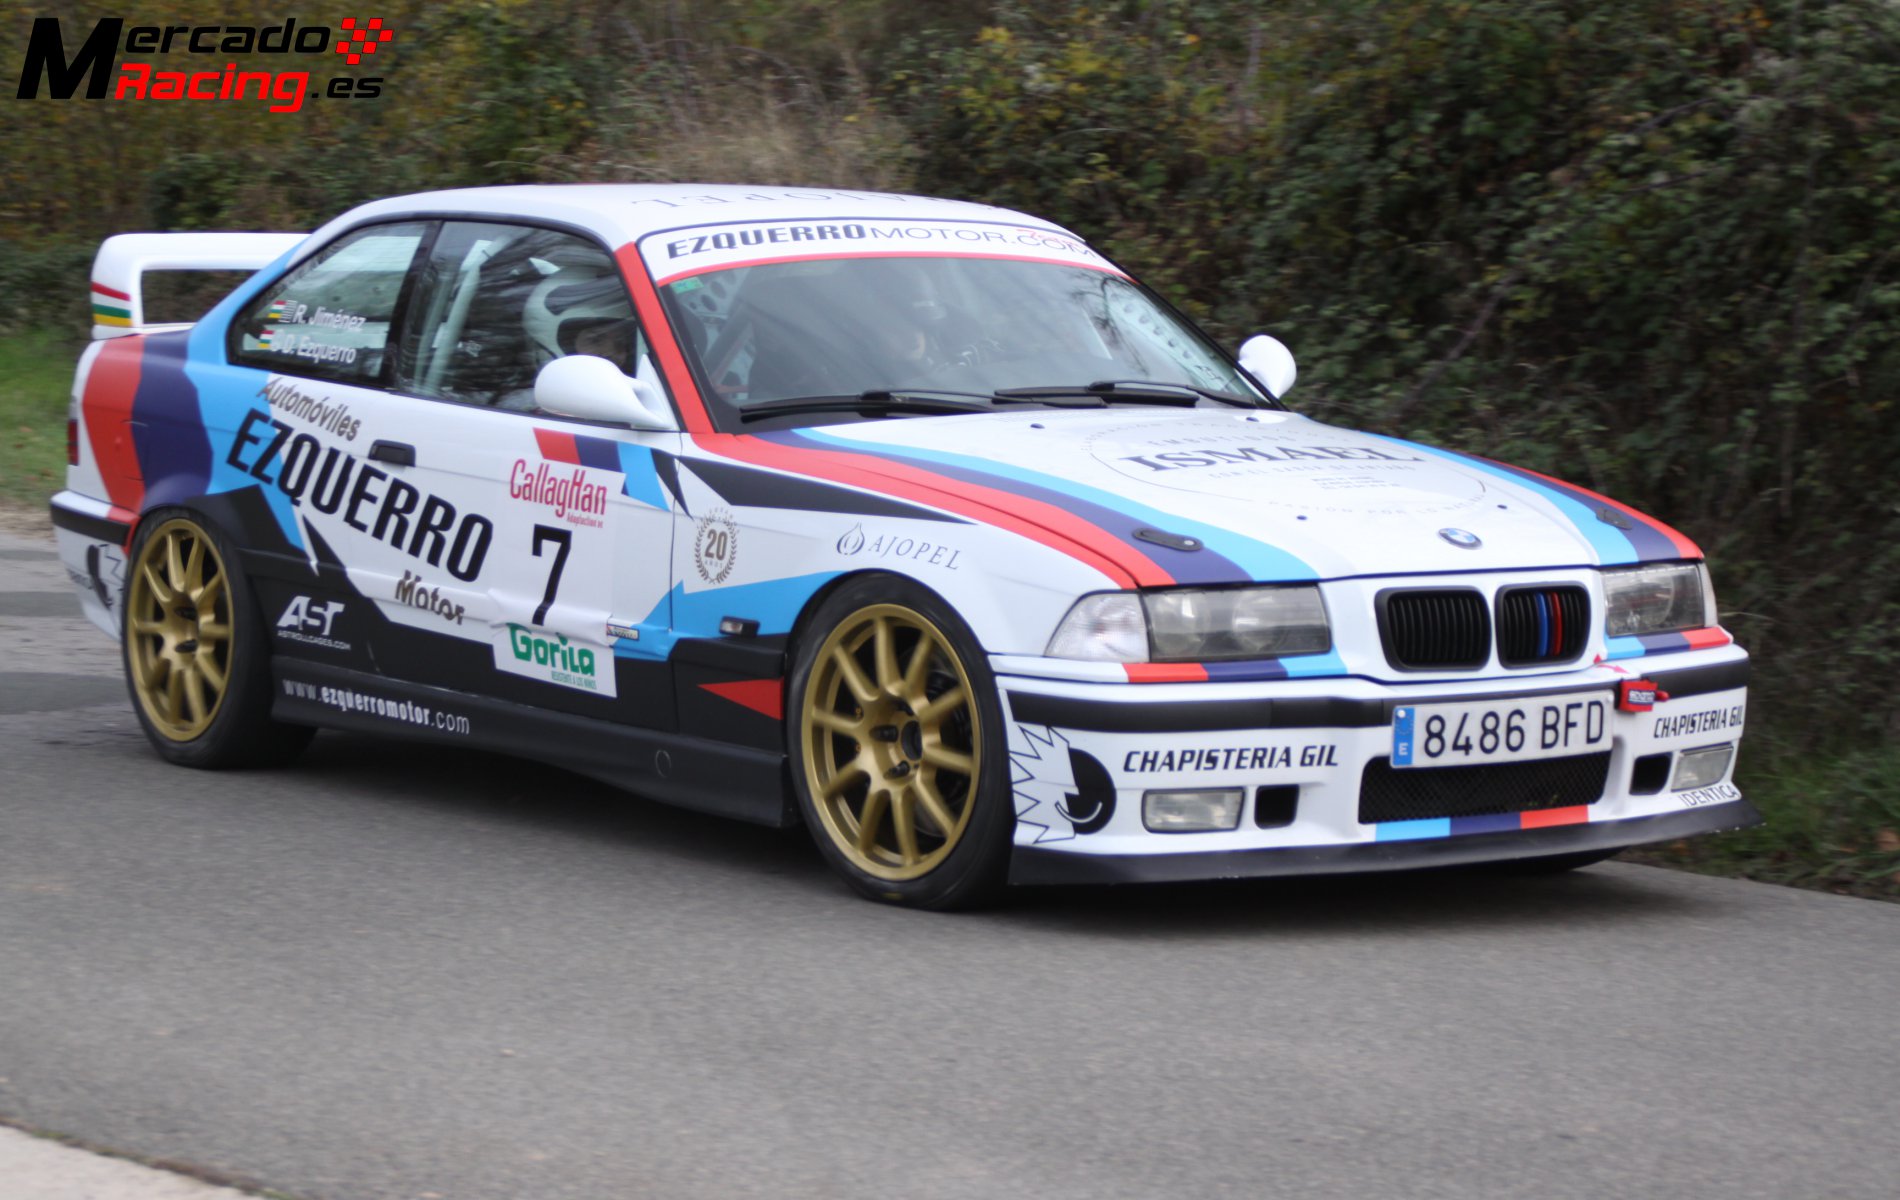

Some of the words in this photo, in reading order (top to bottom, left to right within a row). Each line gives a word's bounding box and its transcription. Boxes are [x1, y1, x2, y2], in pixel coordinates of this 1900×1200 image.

[292, 304, 306, 324] R.
[308, 306, 367, 332] Jiménez
[296, 336, 357, 364] Ezquerro
[256, 376, 361, 442] Automóviles
[1117, 446, 1427, 471] ISMAEL
[226, 407, 494, 583] EZQUERRO
[704, 528, 728, 561] 20
[868, 534, 961, 570] AJOPEL
[532, 524, 573, 627] 7
[395, 570, 466, 626] Motor
[276, 595, 346, 637] AST
[282, 679, 471, 735] www.ezquerromotor.com
[1652, 707, 1728, 739] CHAPISTERIA
[1423, 708, 1526, 759] 8486
[1541, 700, 1605, 750] BFD
[1122, 746, 1292, 774] CHAPISTERIA
[1299, 744, 1339, 768] GIL
[1398, 742, 1409, 757] E
[1678, 784, 1738, 808] IDENTICA
